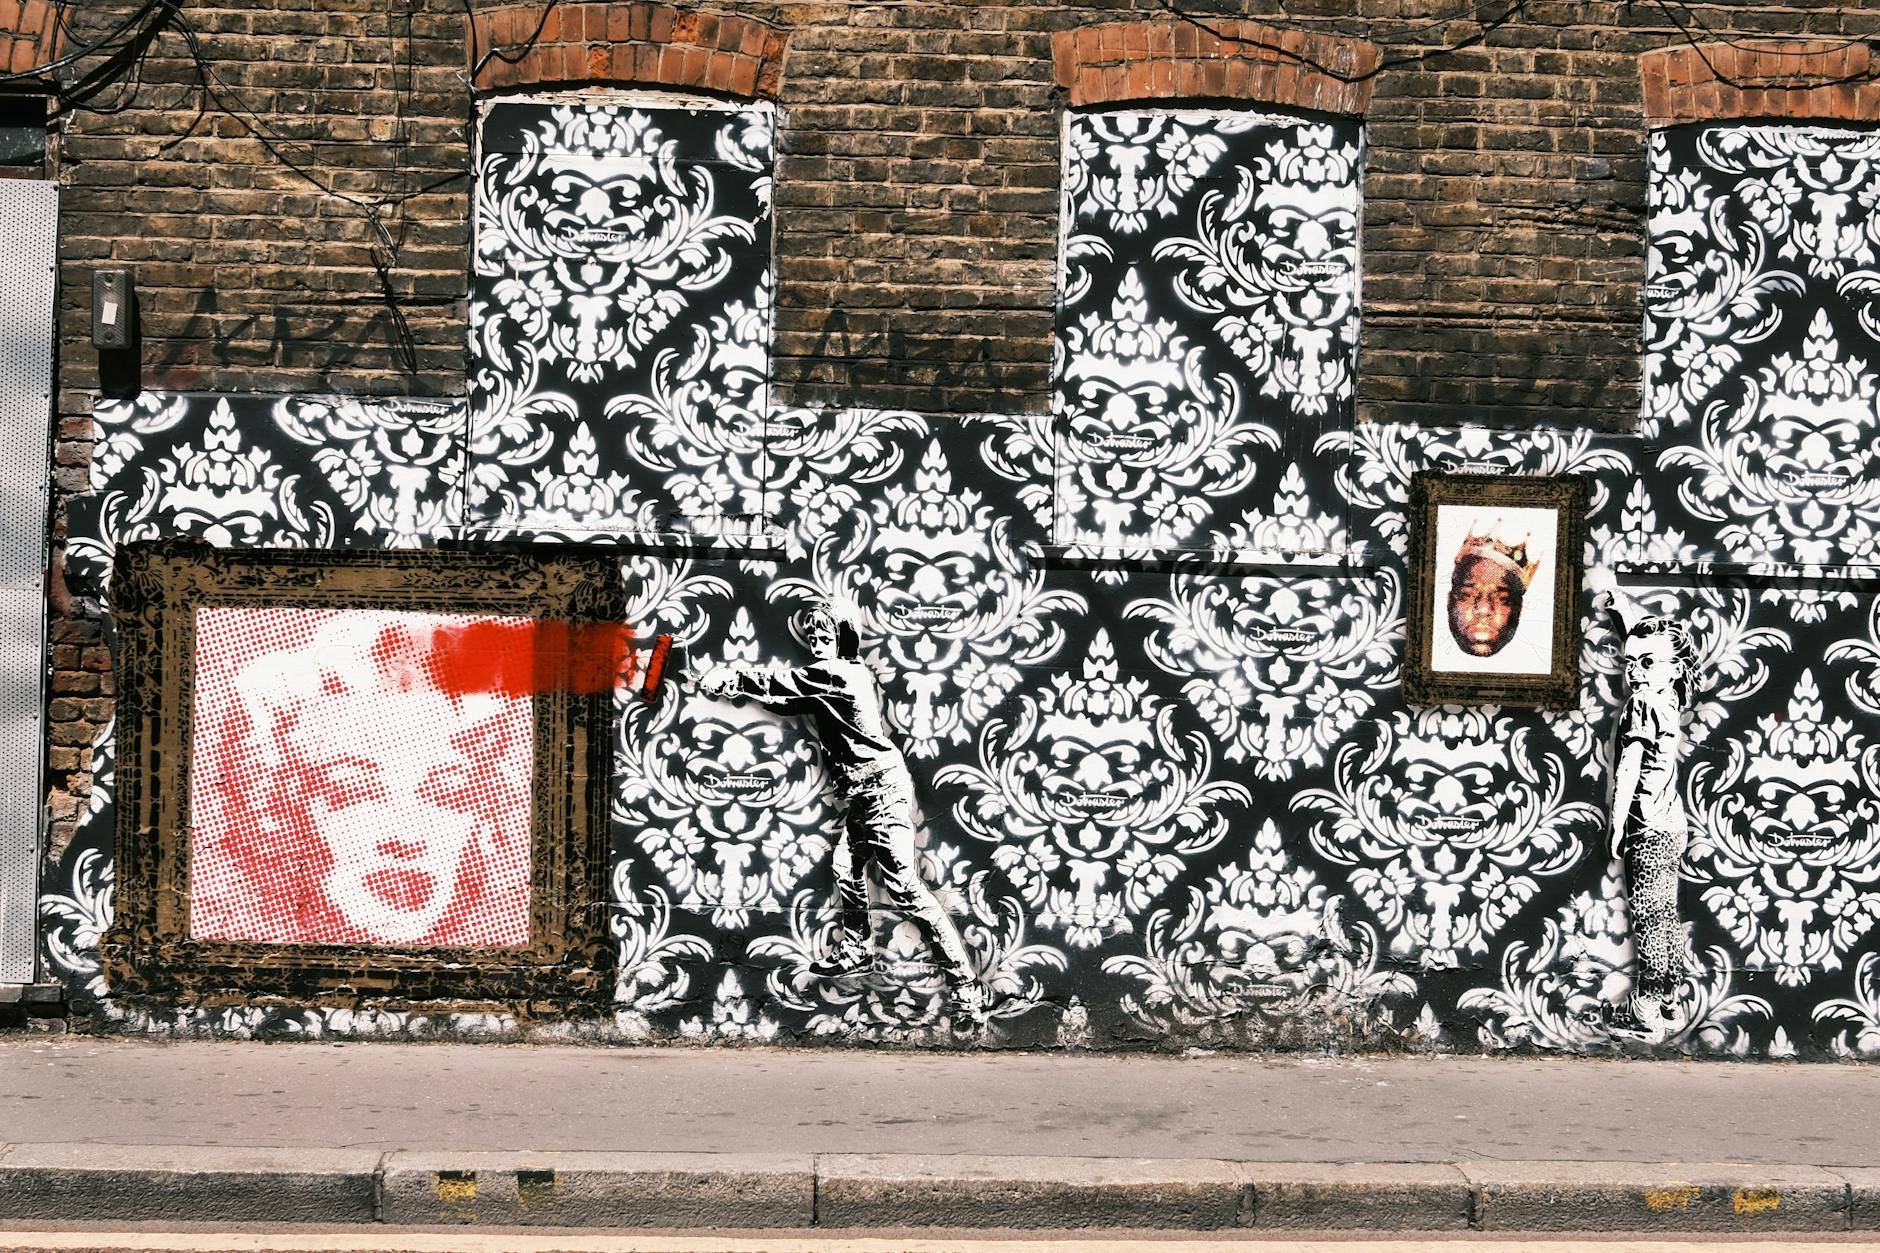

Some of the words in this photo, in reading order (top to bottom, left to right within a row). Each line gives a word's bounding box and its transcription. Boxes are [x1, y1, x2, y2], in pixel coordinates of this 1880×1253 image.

[561, 226, 628, 243] Dotmaster
[1280, 260, 1347, 276] Dotmaster
[1086, 431, 1155, 449] Dotmaster
[1440, 459, 1509, 475] Dotmaster
[1783, 471, 1850, 487] Dotmaster
[894, 604, 963, 620] Dotmaster
[1249, 626, 1318, 642] Dotmaster
[703, 773, 772, 788] Dotmaster
[1060, 792, 1128, 807] Dotmaster
[1414, 814, 1482, 830] Dotmaster
[1767, 832, 1835, 847] Dotmaster
